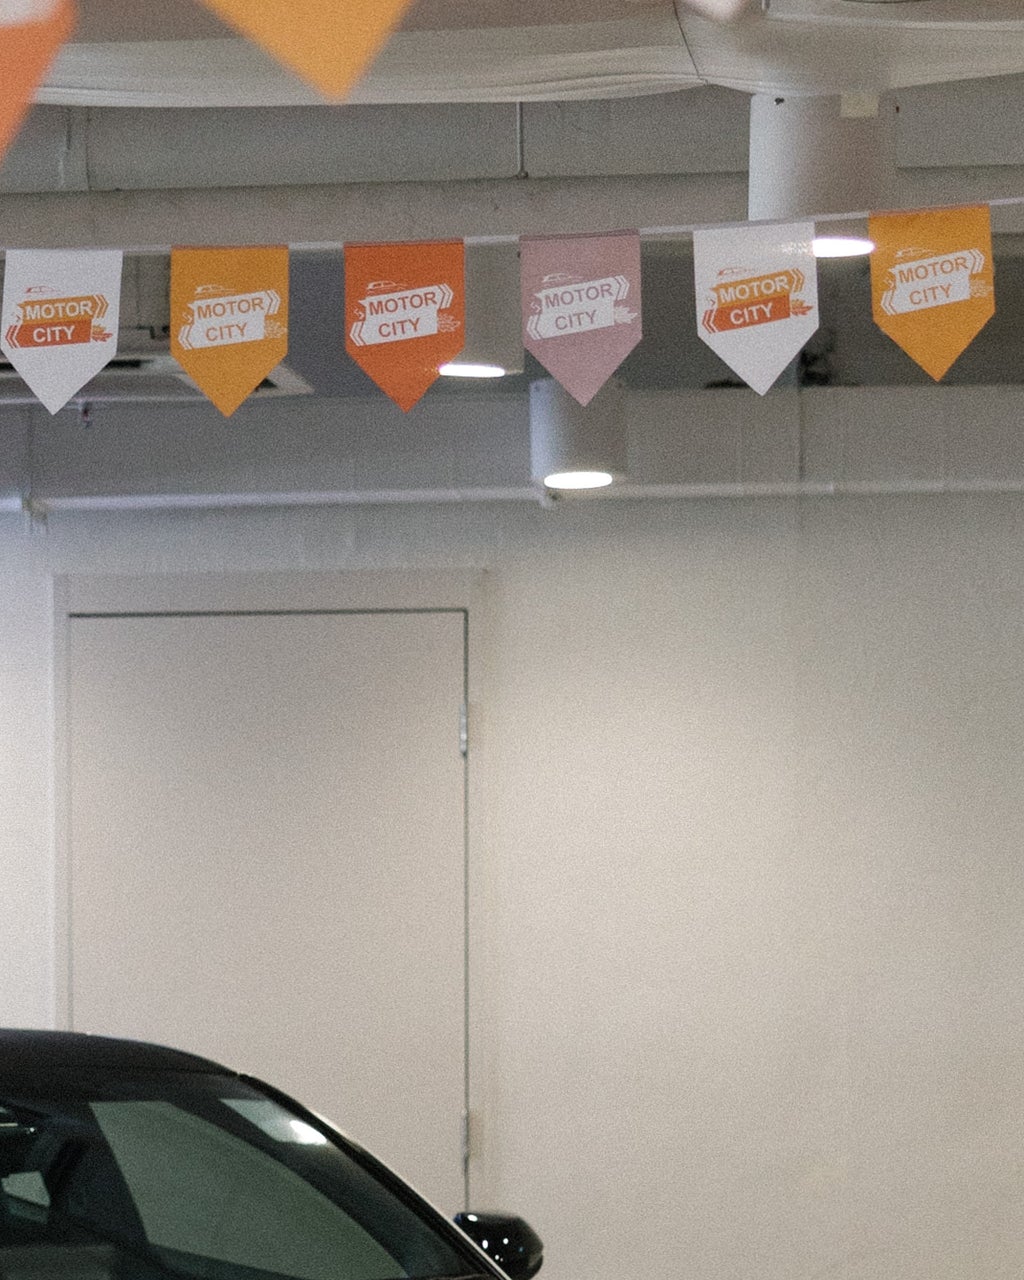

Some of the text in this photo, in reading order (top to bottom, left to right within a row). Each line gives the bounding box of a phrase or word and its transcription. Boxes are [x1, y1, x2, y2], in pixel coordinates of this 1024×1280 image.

[898, 256, 968, 284] MOTOR
[545, 283, 614, 309] MOTOR
[719, 275, 790, 304] MOTOR
[909, 283, 952, 305] CITY
[25, 300, 94, 320] MOTOR
[197, 297, 264, 319] MOTOR
[369, 292, 438, 316] MOTOR
[730, 302, 773, 325] CITY
[378, 317, 420, 337] CITY
[555, 310, 597, 330] CITY
[33, 325, 75, 343] CITY
[205, 322, 247, 342] CITY
